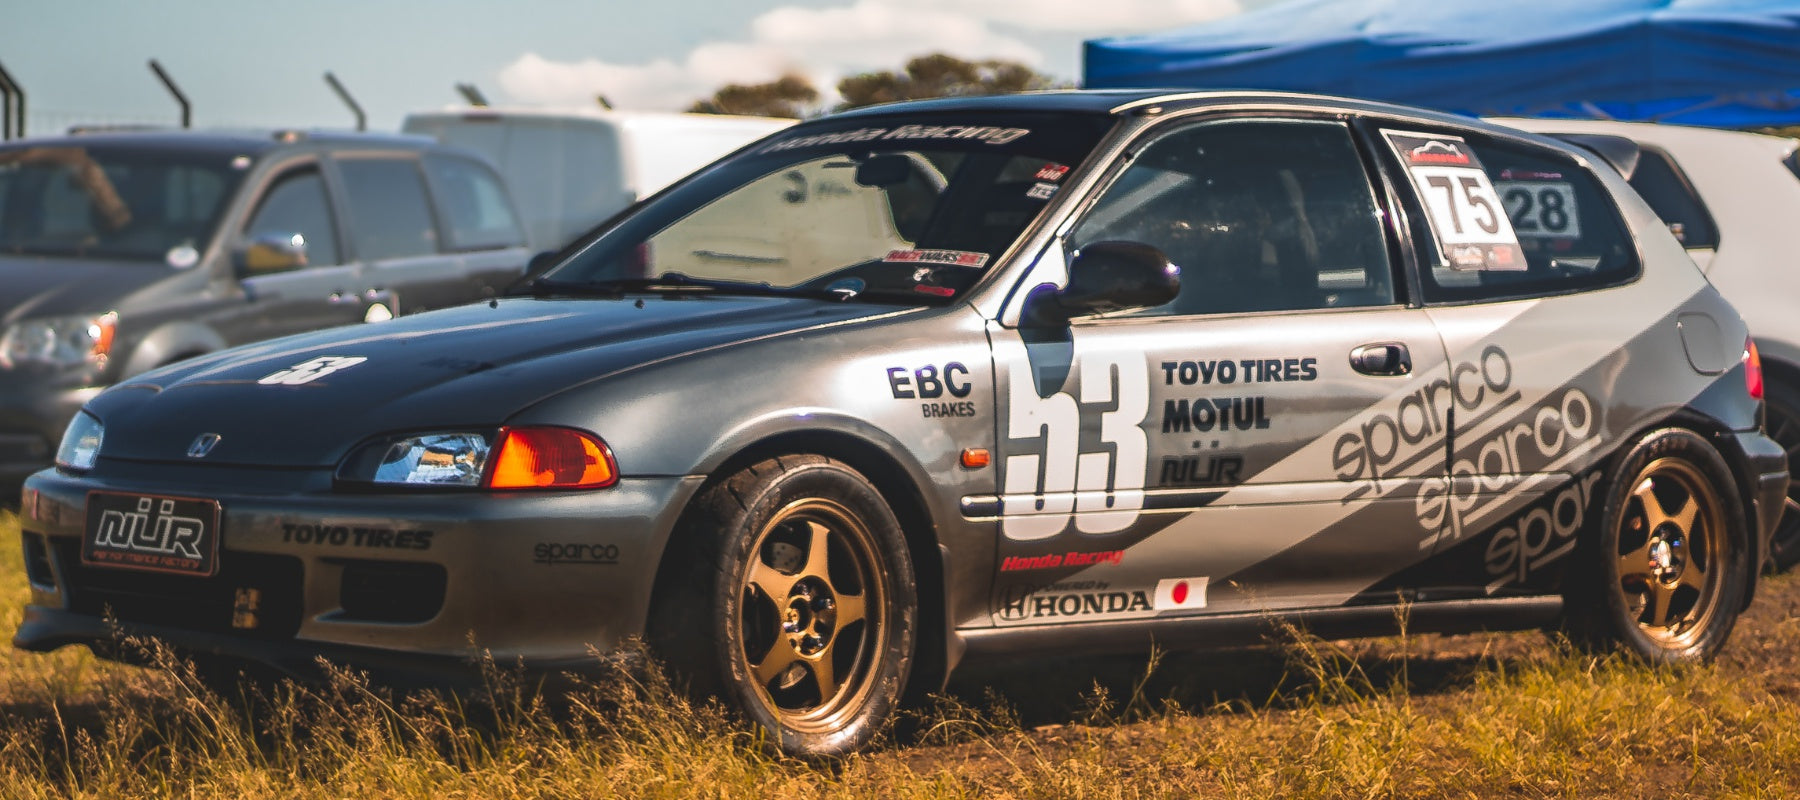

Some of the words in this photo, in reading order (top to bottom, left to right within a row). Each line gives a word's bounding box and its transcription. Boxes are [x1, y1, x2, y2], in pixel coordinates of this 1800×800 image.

[759, 127, 886, 154] Honda
[881, 124, 1030, 145] Racing
[1426, 175, 1499, 235] 75
[1504, 188, 1569, 233] 28
[886, 361, 973, 400] EBC
[1161, 360, 1237, 386] TOYO
[1240, 357, 1318, 383] TIRES
[921, 402, 976, 419] BRAKES
[1161, 396, 1271, 434] MOTUL
[1332, 345, 1513, 494] sparco
[1002, 350, 1150, 541] 53
[1416, 387, 1593, 538] sparco
[95, 497, 203, 559] NÜR
[281, 523, 349, 547] TOYO
[350, 527, 435, 550] TIRES
[533, 541, 620, 565] sparco
[1001, 554, 1059, 571] Honda
[1063, 550, 1125, 565] Racing
[1033, 591, 1153, 617] HONDA
